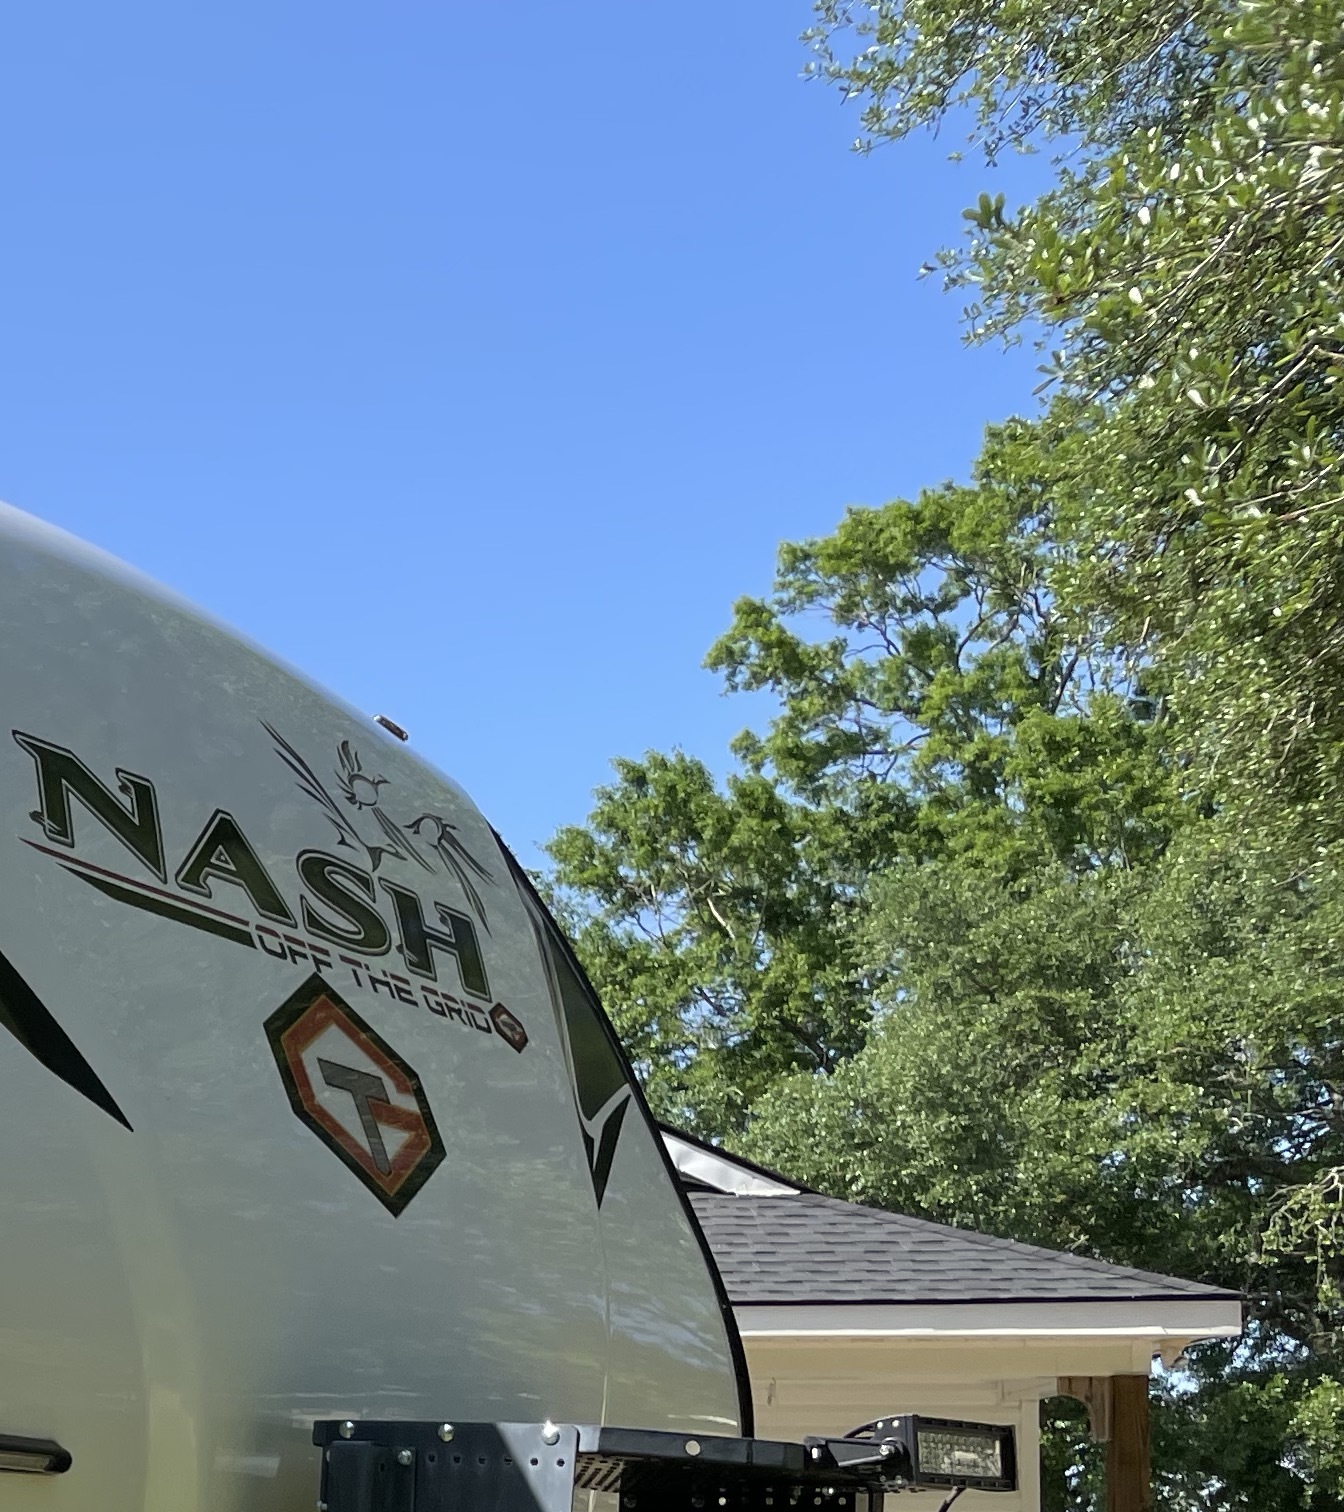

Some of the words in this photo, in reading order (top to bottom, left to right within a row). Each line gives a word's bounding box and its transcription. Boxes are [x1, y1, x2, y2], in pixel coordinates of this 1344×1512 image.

[12, 729, 493, 1003] NASH
[251, 924, 334, 974] OFF
[339, 954, 420, 1006] THE
[420, 984, 494, 1035] GRID
